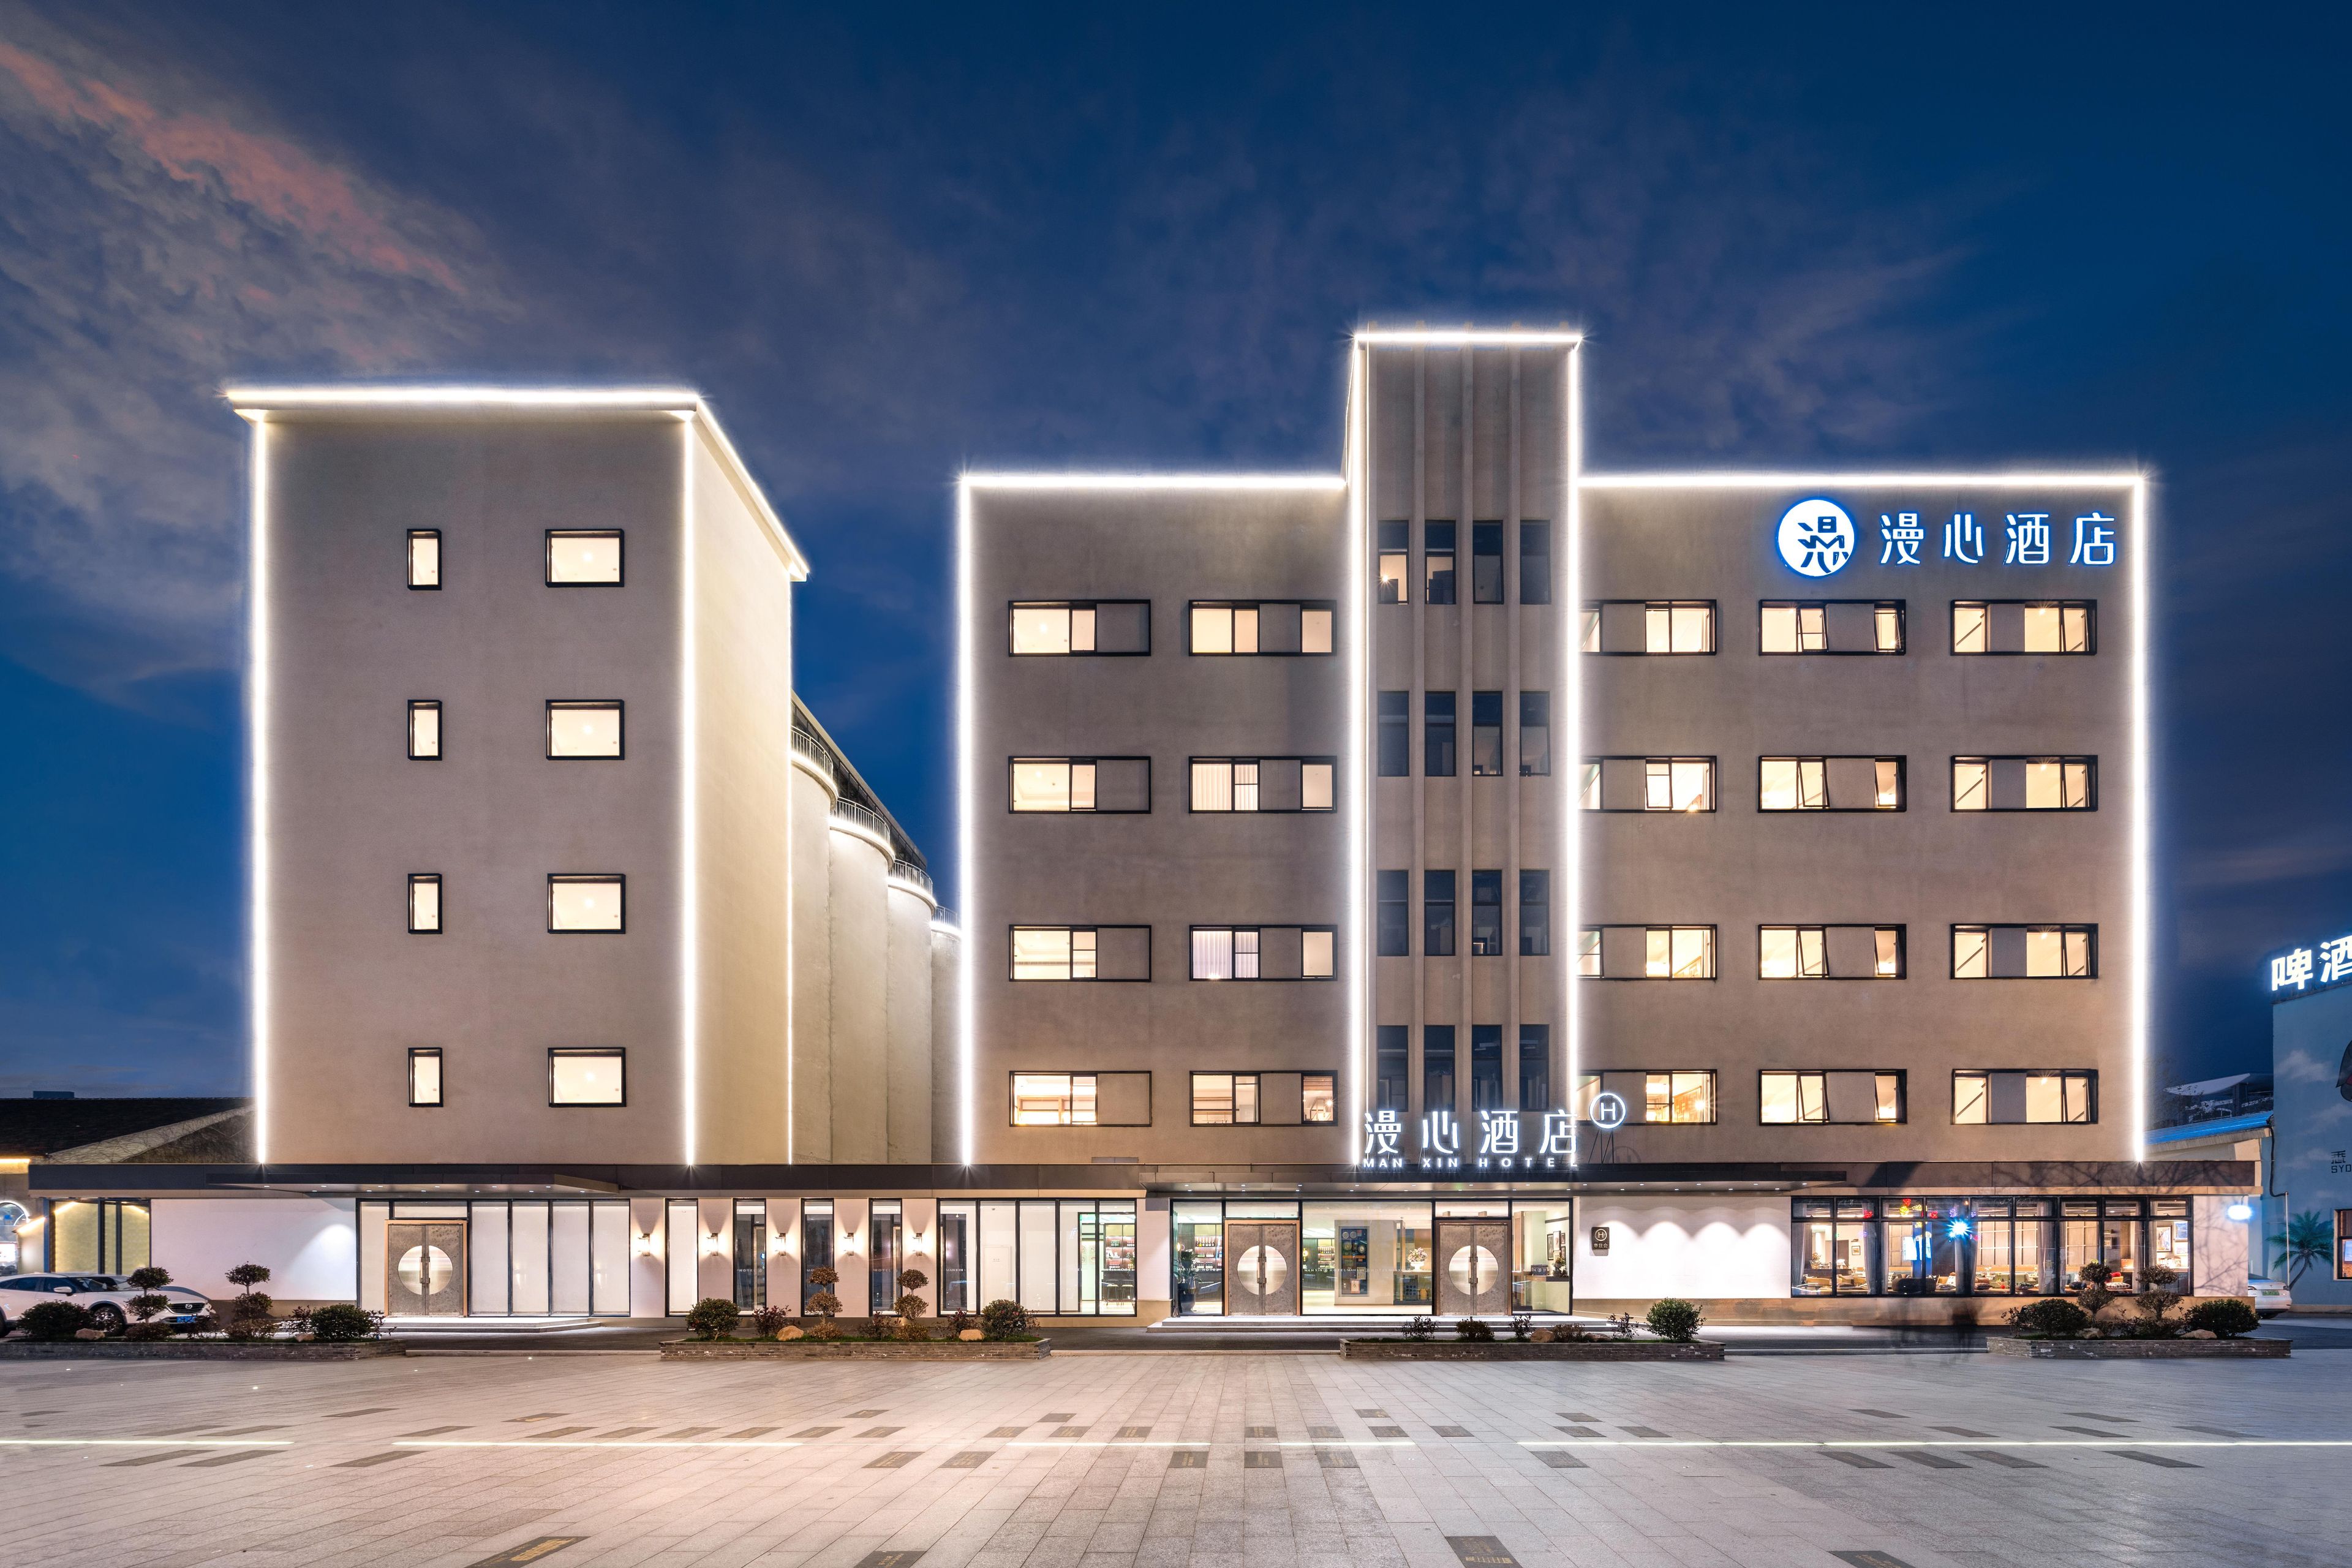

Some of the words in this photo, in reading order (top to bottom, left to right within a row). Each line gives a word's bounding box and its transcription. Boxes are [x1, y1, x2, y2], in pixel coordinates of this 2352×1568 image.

[1880, 512, 2116, 565] 漫心酒店
[2271, 935, 2352, 991] 啤酒
[1363, 1109, 1578, 1155] 漫心酒店
[1363, 1158, 1403, 1167] MAN
[1422, 1158, 1459, 1167] XIN
[1478, 1158, 1578, 1168] HOTEL
